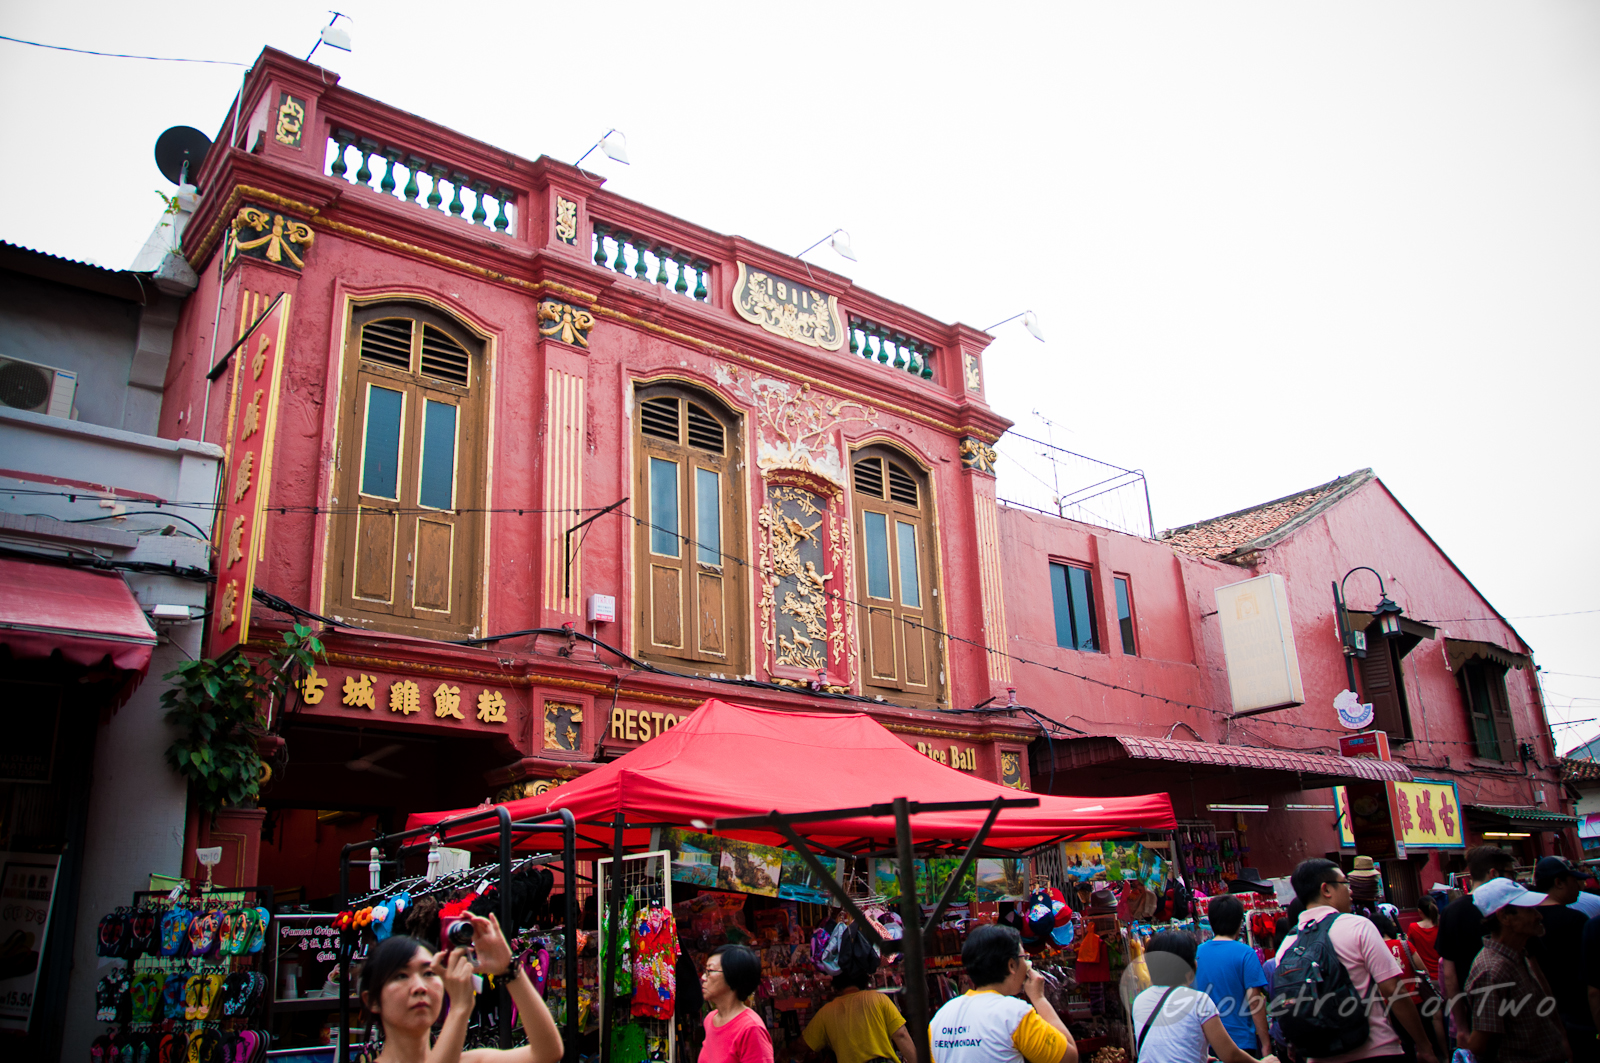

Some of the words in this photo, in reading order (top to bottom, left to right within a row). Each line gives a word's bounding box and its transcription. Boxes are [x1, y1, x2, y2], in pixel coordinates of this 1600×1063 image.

[767, 278, 808, 309] 1911
[295, 668, 508, 723] 古城雞飯粒
[612, 707, 687, 743] RESTO
[950, 745, 977, 771] Ball
[313, 925, 341, 938] Origin
